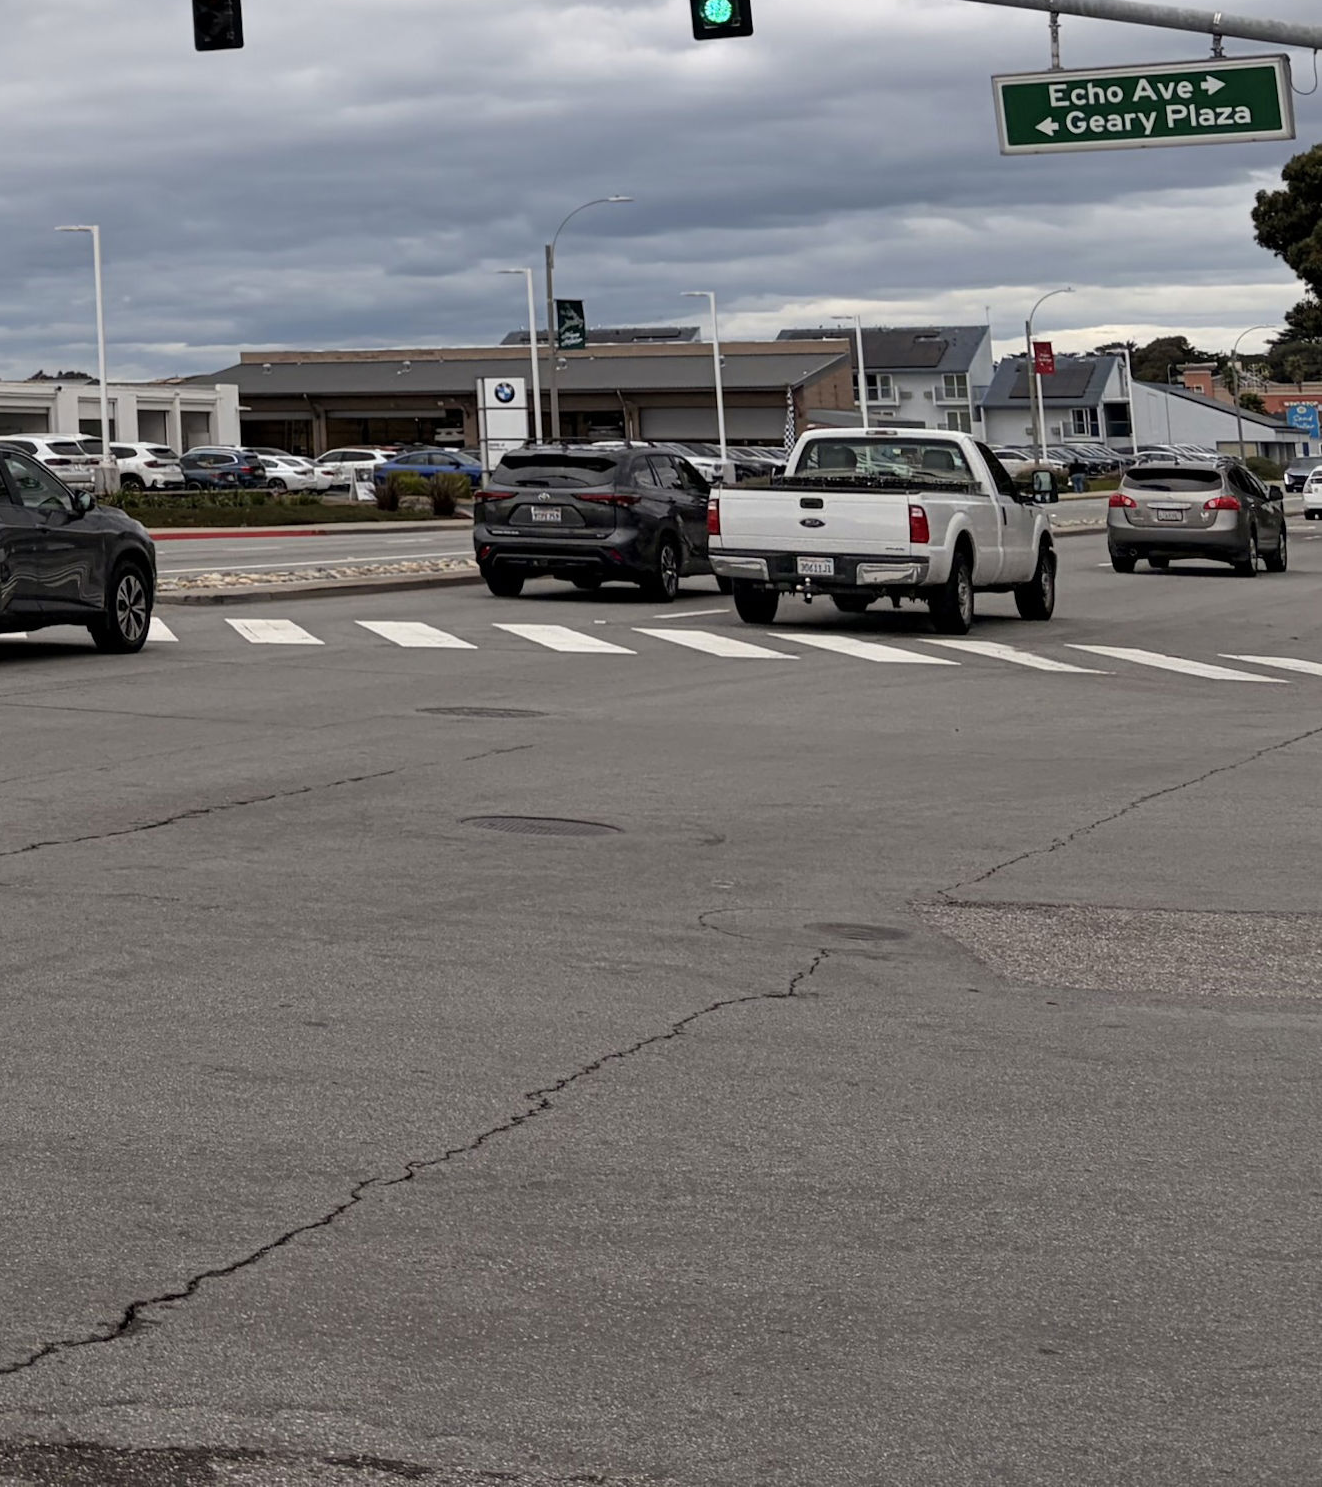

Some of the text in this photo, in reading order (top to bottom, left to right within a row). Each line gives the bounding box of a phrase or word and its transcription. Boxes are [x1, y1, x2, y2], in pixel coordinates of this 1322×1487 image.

[1048, 78, 1194, 108] Echo Ave
[1065, 103, 1252, 135] Geary Plaza
